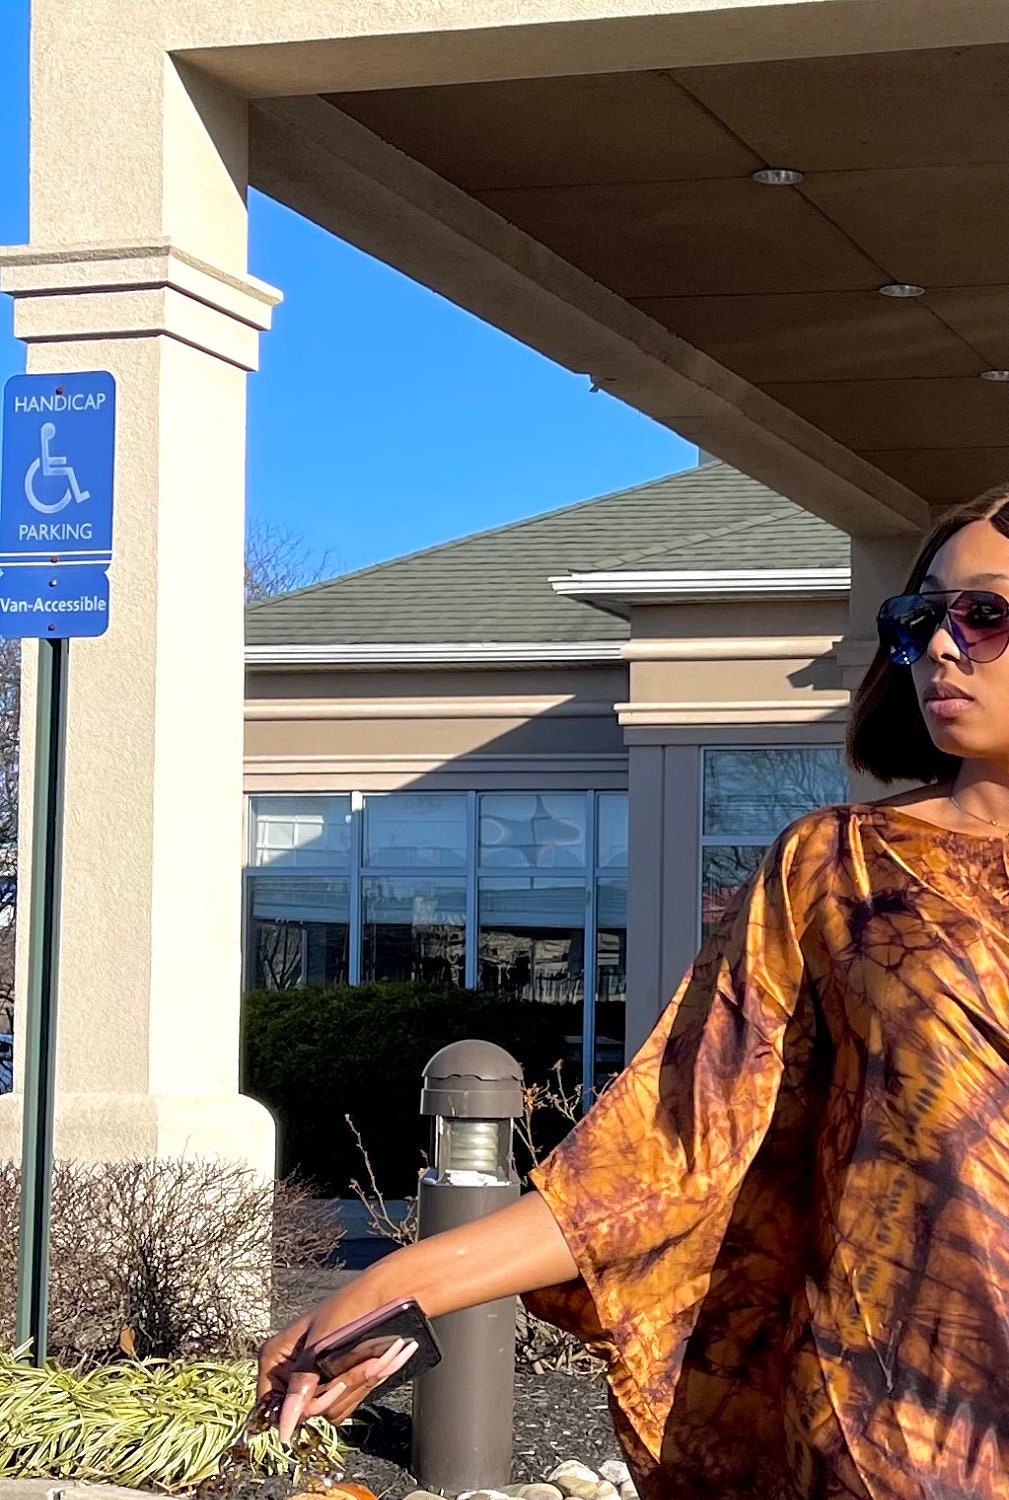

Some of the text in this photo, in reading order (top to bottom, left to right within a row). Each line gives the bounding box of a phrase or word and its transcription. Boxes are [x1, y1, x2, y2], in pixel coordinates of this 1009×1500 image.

[15, 393, 106, 412] HANDICAP
[19, 523, 92, 540] PARKING
[0, 596, 106, 612] Van-Accessible
